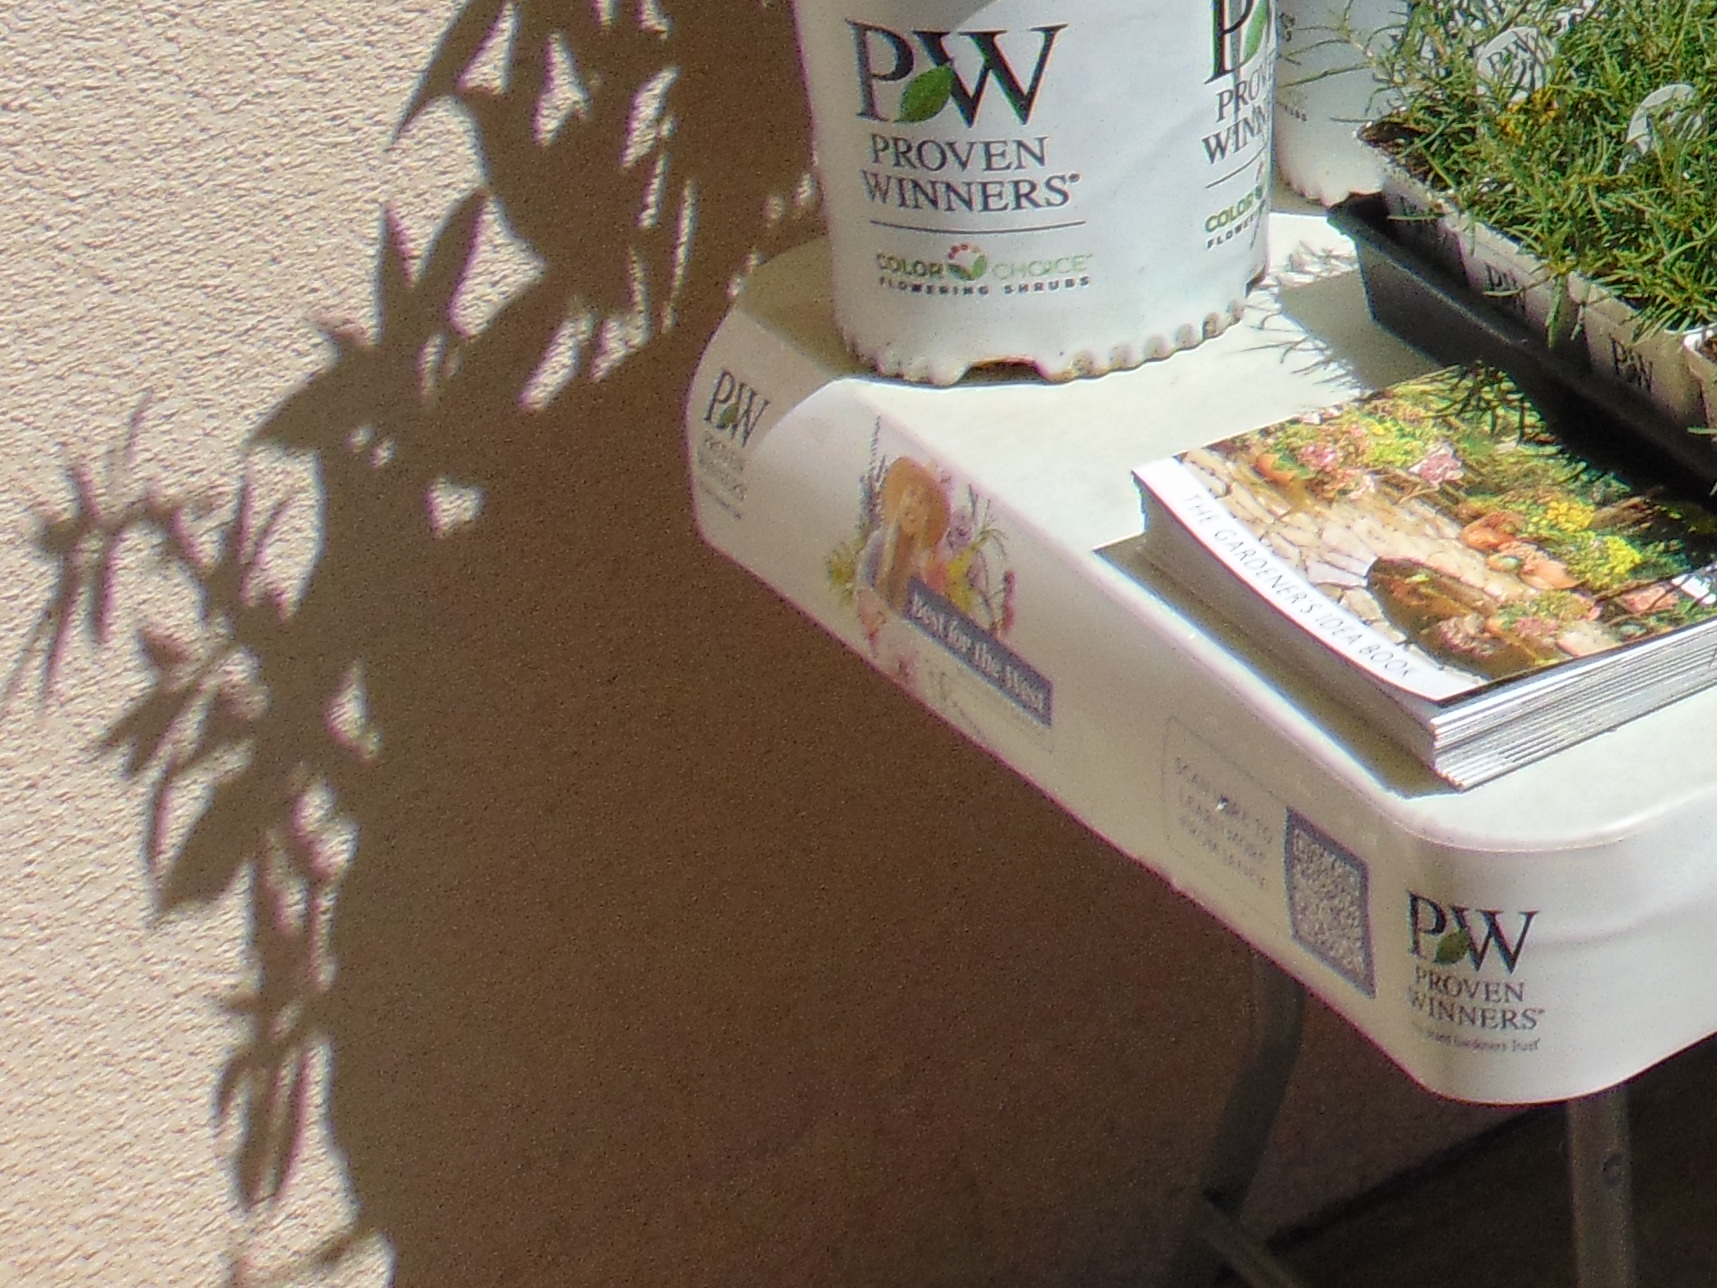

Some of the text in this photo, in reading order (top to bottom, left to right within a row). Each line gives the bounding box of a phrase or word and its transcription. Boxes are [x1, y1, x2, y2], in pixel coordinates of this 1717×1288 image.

[845, 18, 1068, 128] PW
[870, 133, 1049, 172] PROVEN
[859, 170, 1072, 213] WINNERS
[876, 253, 1088, 280] COLOR CHOICE
[1003, 275, 1090, 296] SHRUBS
[704, 370, 770, 448] PW
[1182, 494, 1418, 679] THE GARDENER'S IDEA BOOK
[1406, 889, 1540, 975] PW
[1414, 965, 1525, 1003] PROVEN
[1408, 986, 1538, 1030] WINNERS
